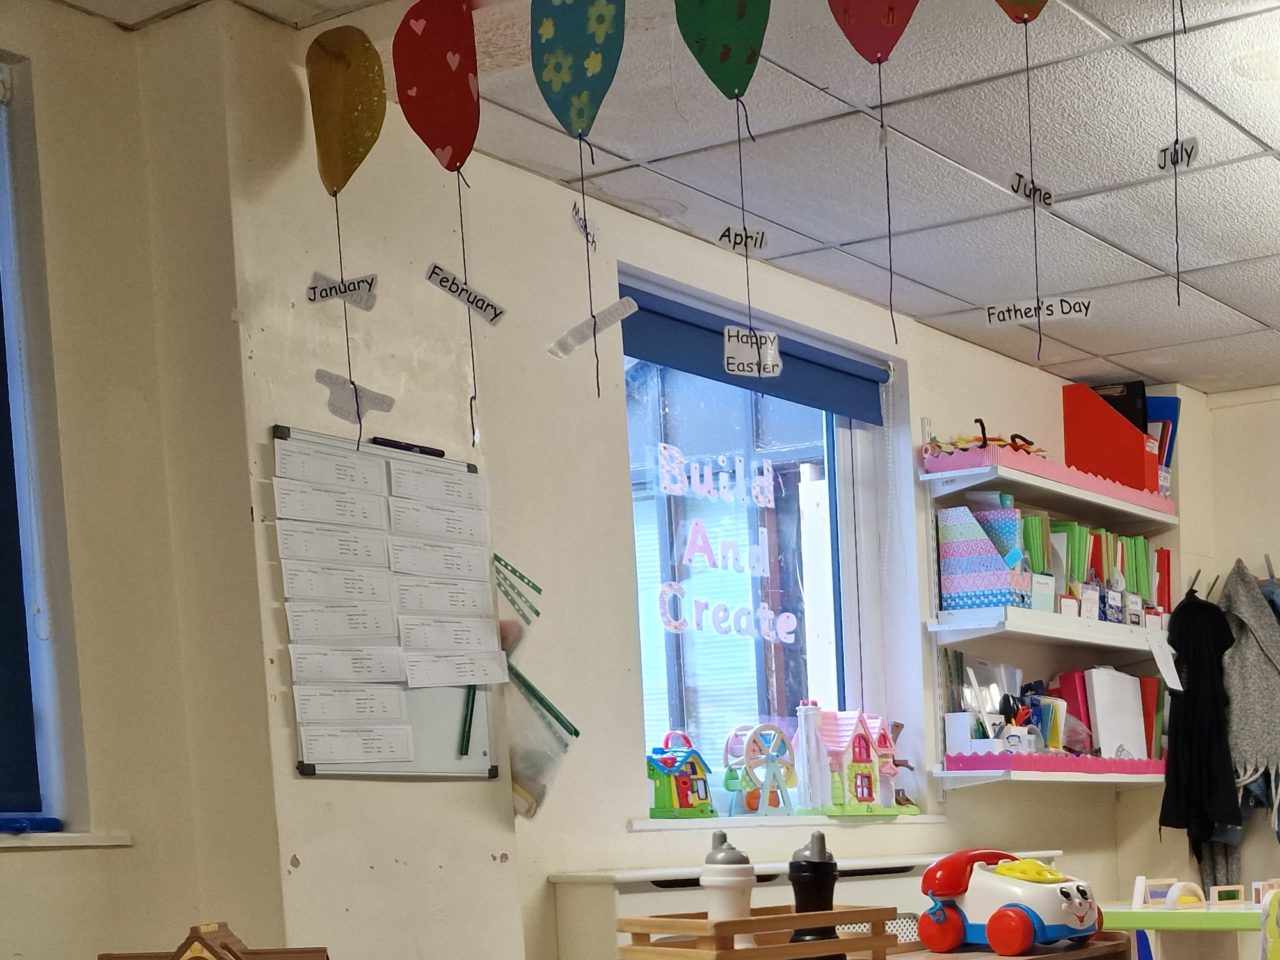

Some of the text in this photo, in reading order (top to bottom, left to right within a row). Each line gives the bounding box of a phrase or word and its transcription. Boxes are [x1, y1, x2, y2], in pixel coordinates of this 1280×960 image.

[1158, 143, 1195, 170] July
[1011, 172, 1052, 206] June
[719, 226, 766, 249] April
[307, 274, 376, 302] January
[428, 265, 503, 321] February
[987, 299, 1091, 324] Father's Day
[727, 328, 777, 349] Happy
[726, 356, 779, 375] Easter
[658, 442, 775, 508] Build
[682, 518, 770, 578] And
[659, 581, 797, 644] Create
